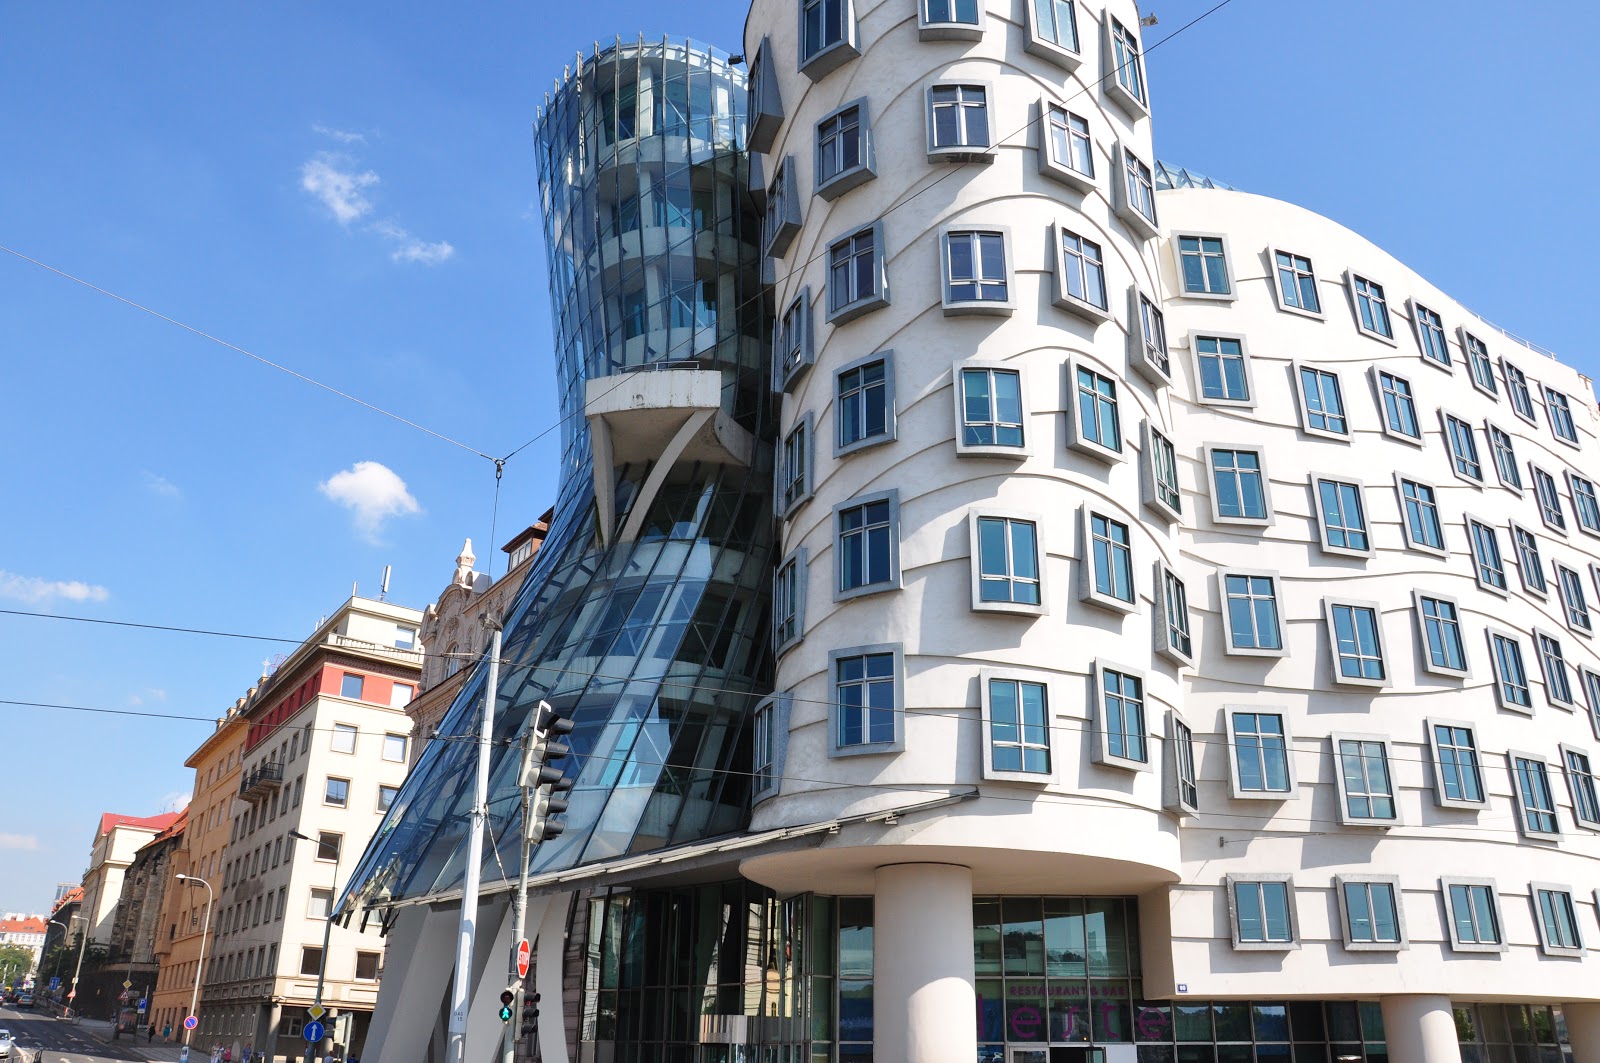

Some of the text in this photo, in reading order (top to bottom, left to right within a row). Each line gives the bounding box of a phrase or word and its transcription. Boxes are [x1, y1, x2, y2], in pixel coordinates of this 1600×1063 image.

[518, 951, 529, 965] STOP
[1010, 985, 1087, 996] RESTAURANT
[1102, 985, 1125, 996] BAR
